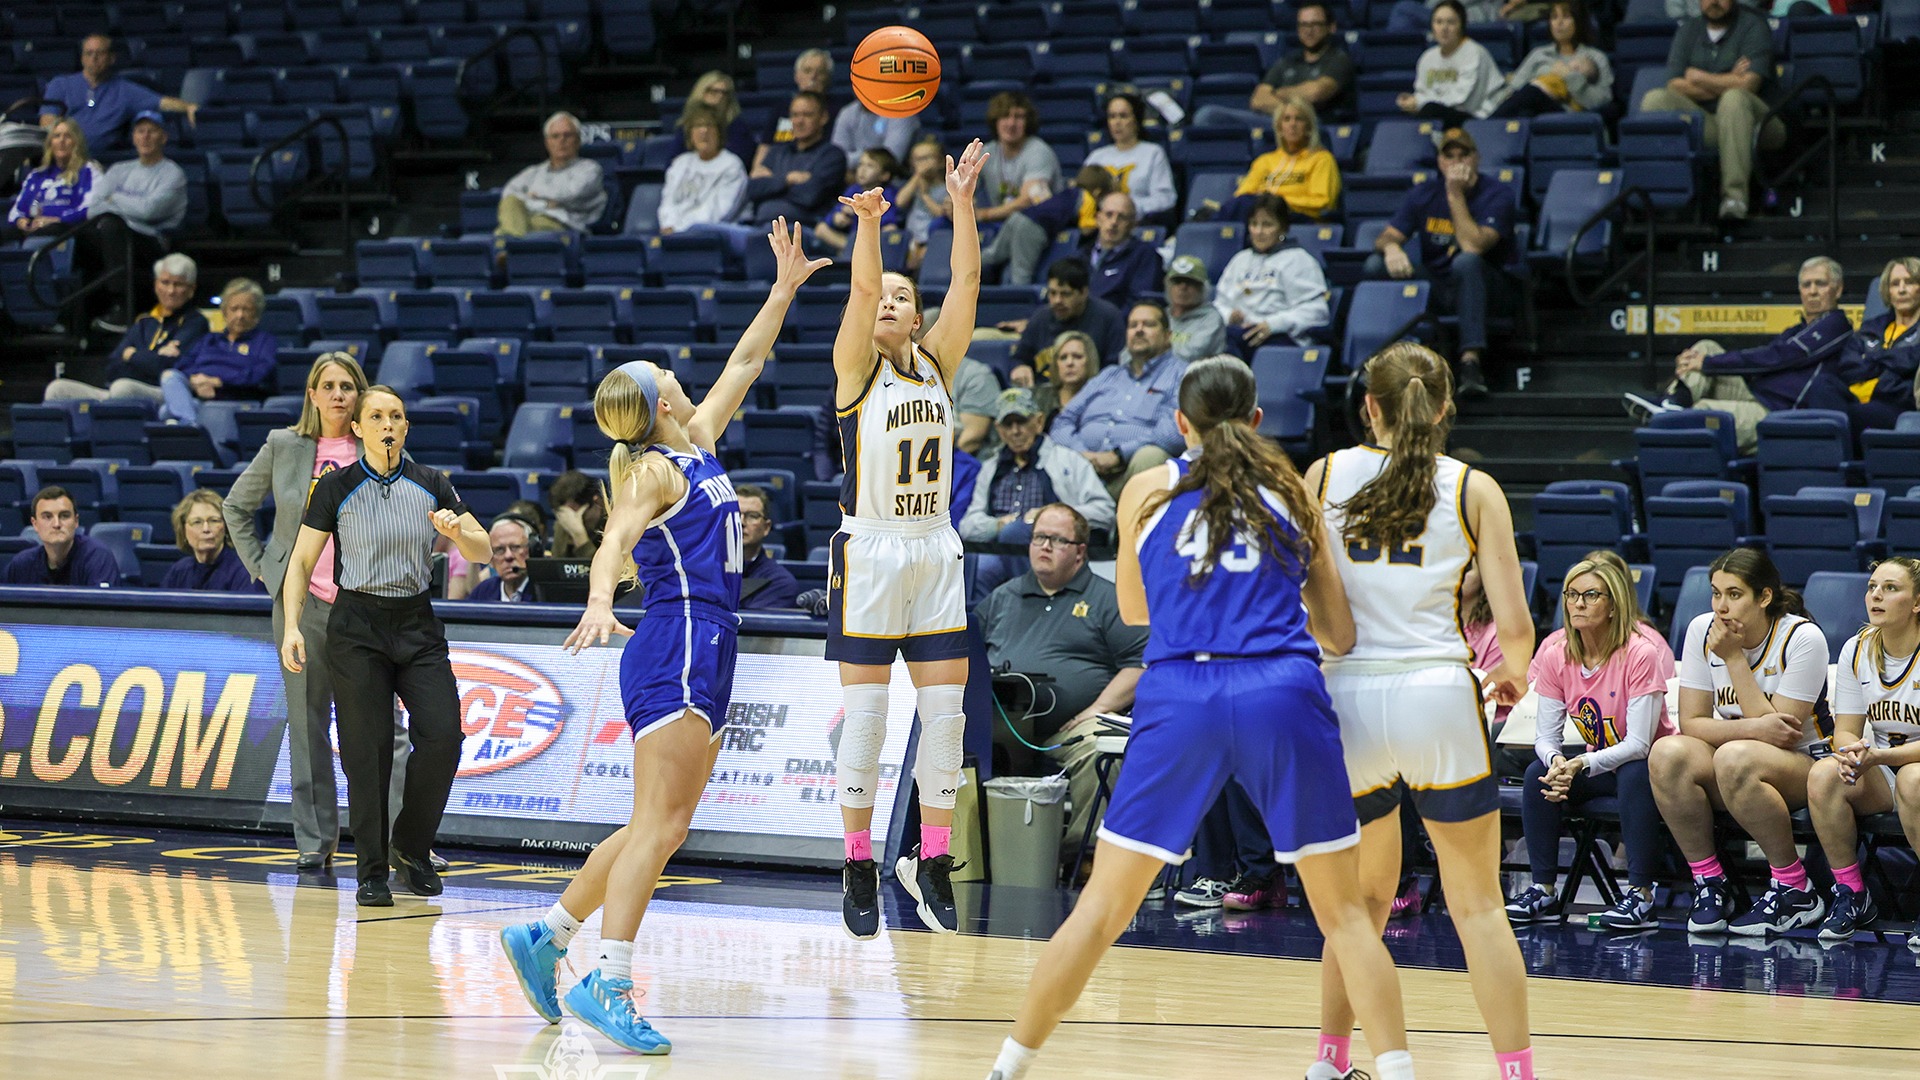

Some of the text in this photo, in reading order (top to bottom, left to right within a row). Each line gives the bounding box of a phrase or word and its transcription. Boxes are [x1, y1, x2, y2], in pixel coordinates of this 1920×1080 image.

[1871, 142, 1886, 163] K
[464, 170, 480, 190] K
[1789, 196, 1802, 218] J
[367, 216, 380, 235] J
[1702, 250, 1719, 272] H
[267, 264, 281, 281] H
[1610, 308, 1626, 331] G
[1692, 309, 1768, 323] BALLARD
[1516, 366, 1531, 390] F
[886, 399, 947, 433] MURRA
[896, 435, 941, 486] 14
[894, 491, 938, 517] STATE
[0, 630, 257, 791] .COM
[473, 739, 514, 761] Air
[583, 761, 775, 788] COOL EATING
[800, 786, 837, 804] ELI
